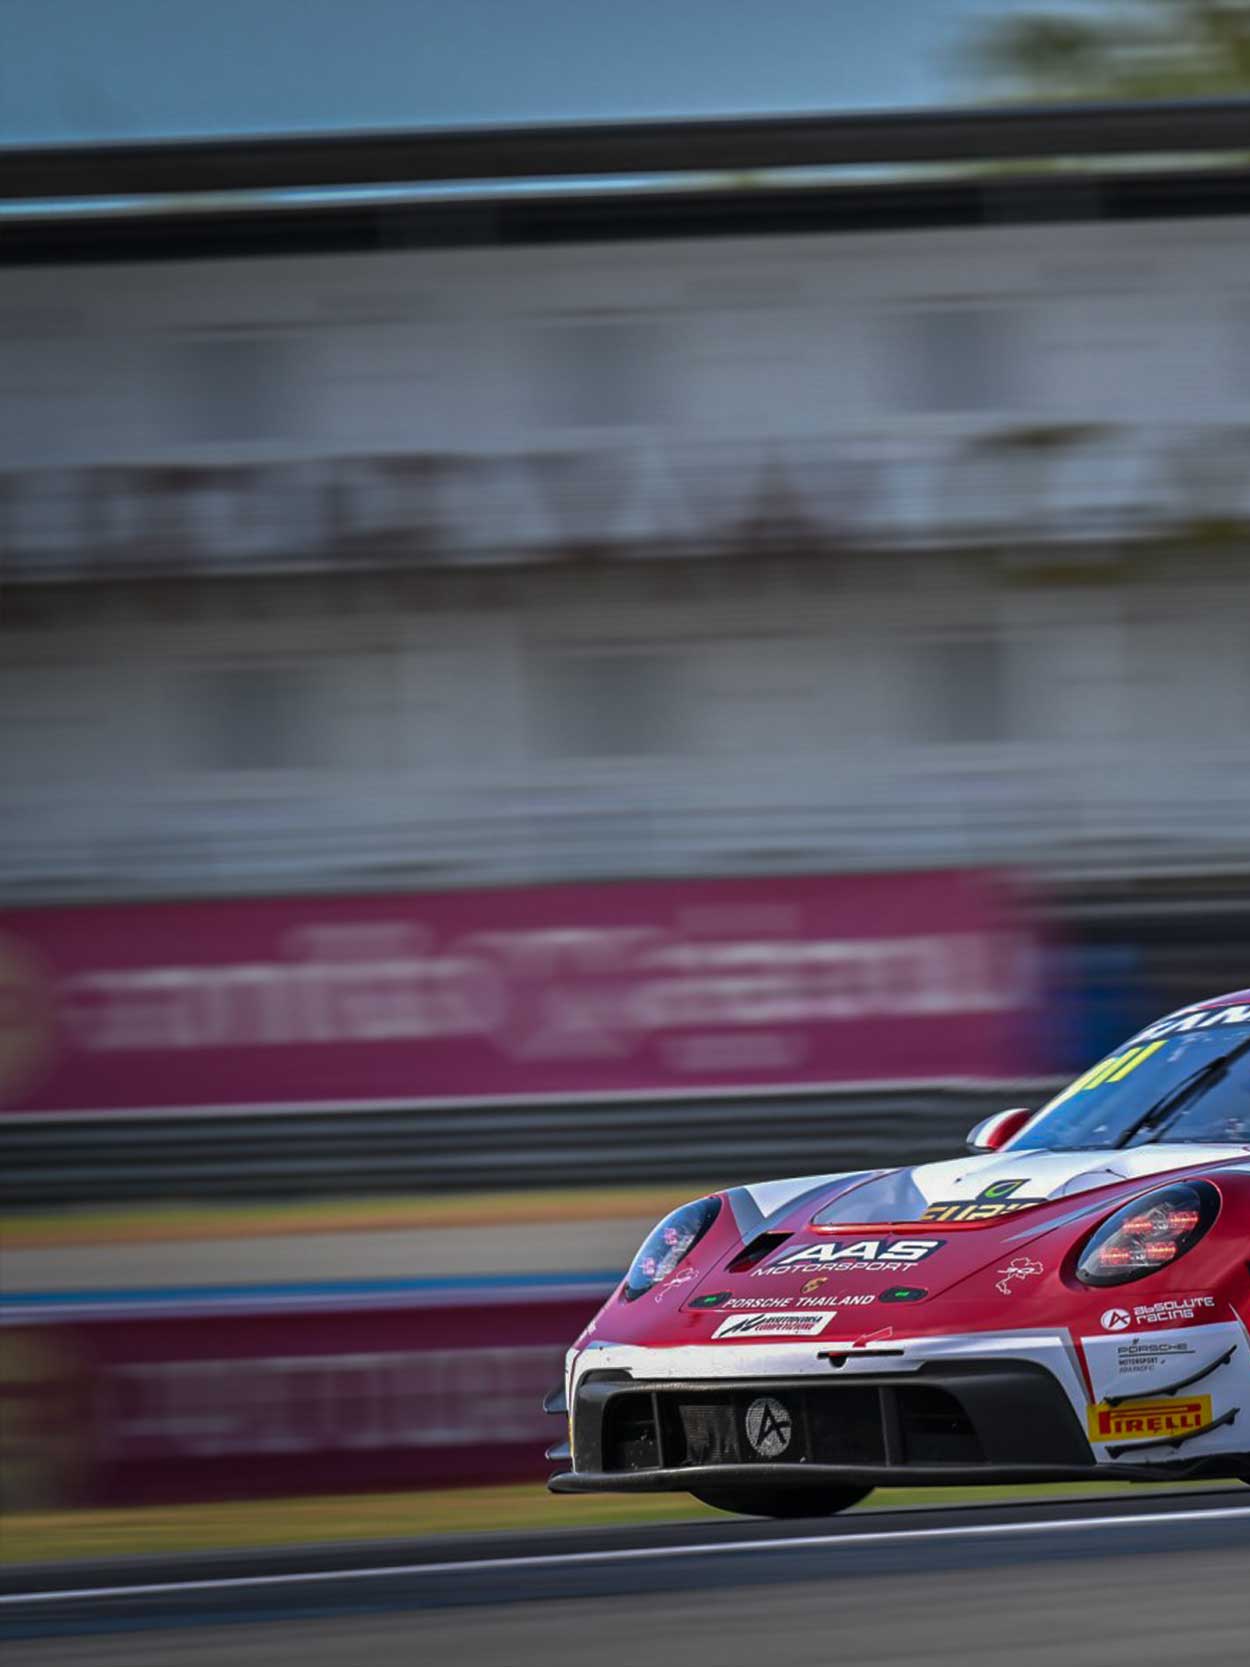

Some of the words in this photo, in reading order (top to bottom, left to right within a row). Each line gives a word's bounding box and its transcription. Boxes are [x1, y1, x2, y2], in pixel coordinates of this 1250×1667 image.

[780, 1241, 939, 1264] AAS
[751, 1262, 918, 1277] MOTORSPORT
[722, 1297, 793, 1309] PORSCHE
[795, 1295, 876, 1308] THAILAND
[1117, 1343, 1188, 1354] PORSCHE
[1098, 1403, 1202, 1435] PIRELLI
